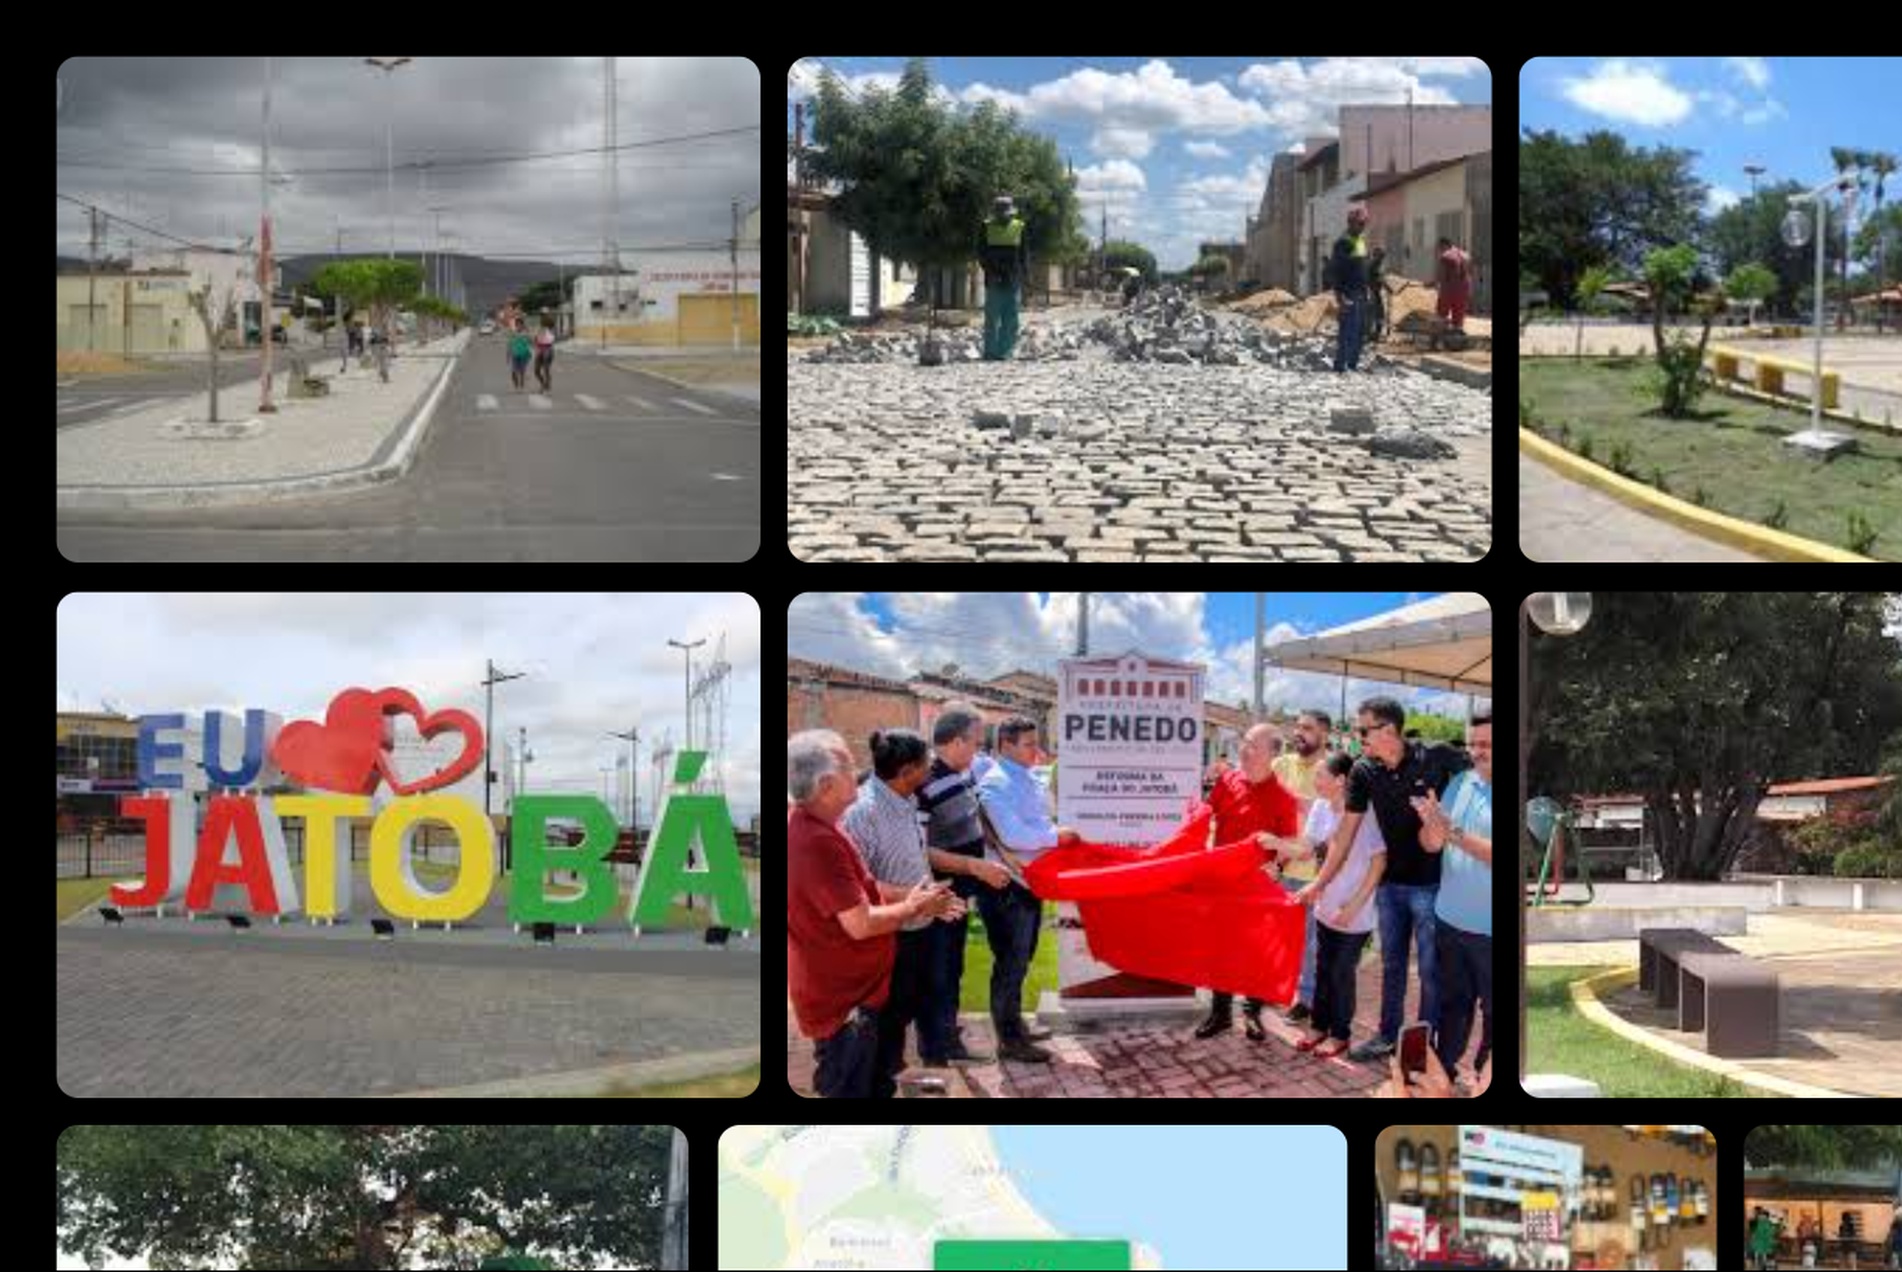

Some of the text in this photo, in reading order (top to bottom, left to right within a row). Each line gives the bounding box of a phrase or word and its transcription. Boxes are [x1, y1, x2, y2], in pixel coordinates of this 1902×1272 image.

[137, 708, 268, 789] EU
[1065, 714, 1197, 743] PENEDO
[108, 750, 752, 927] JATOBÁ
